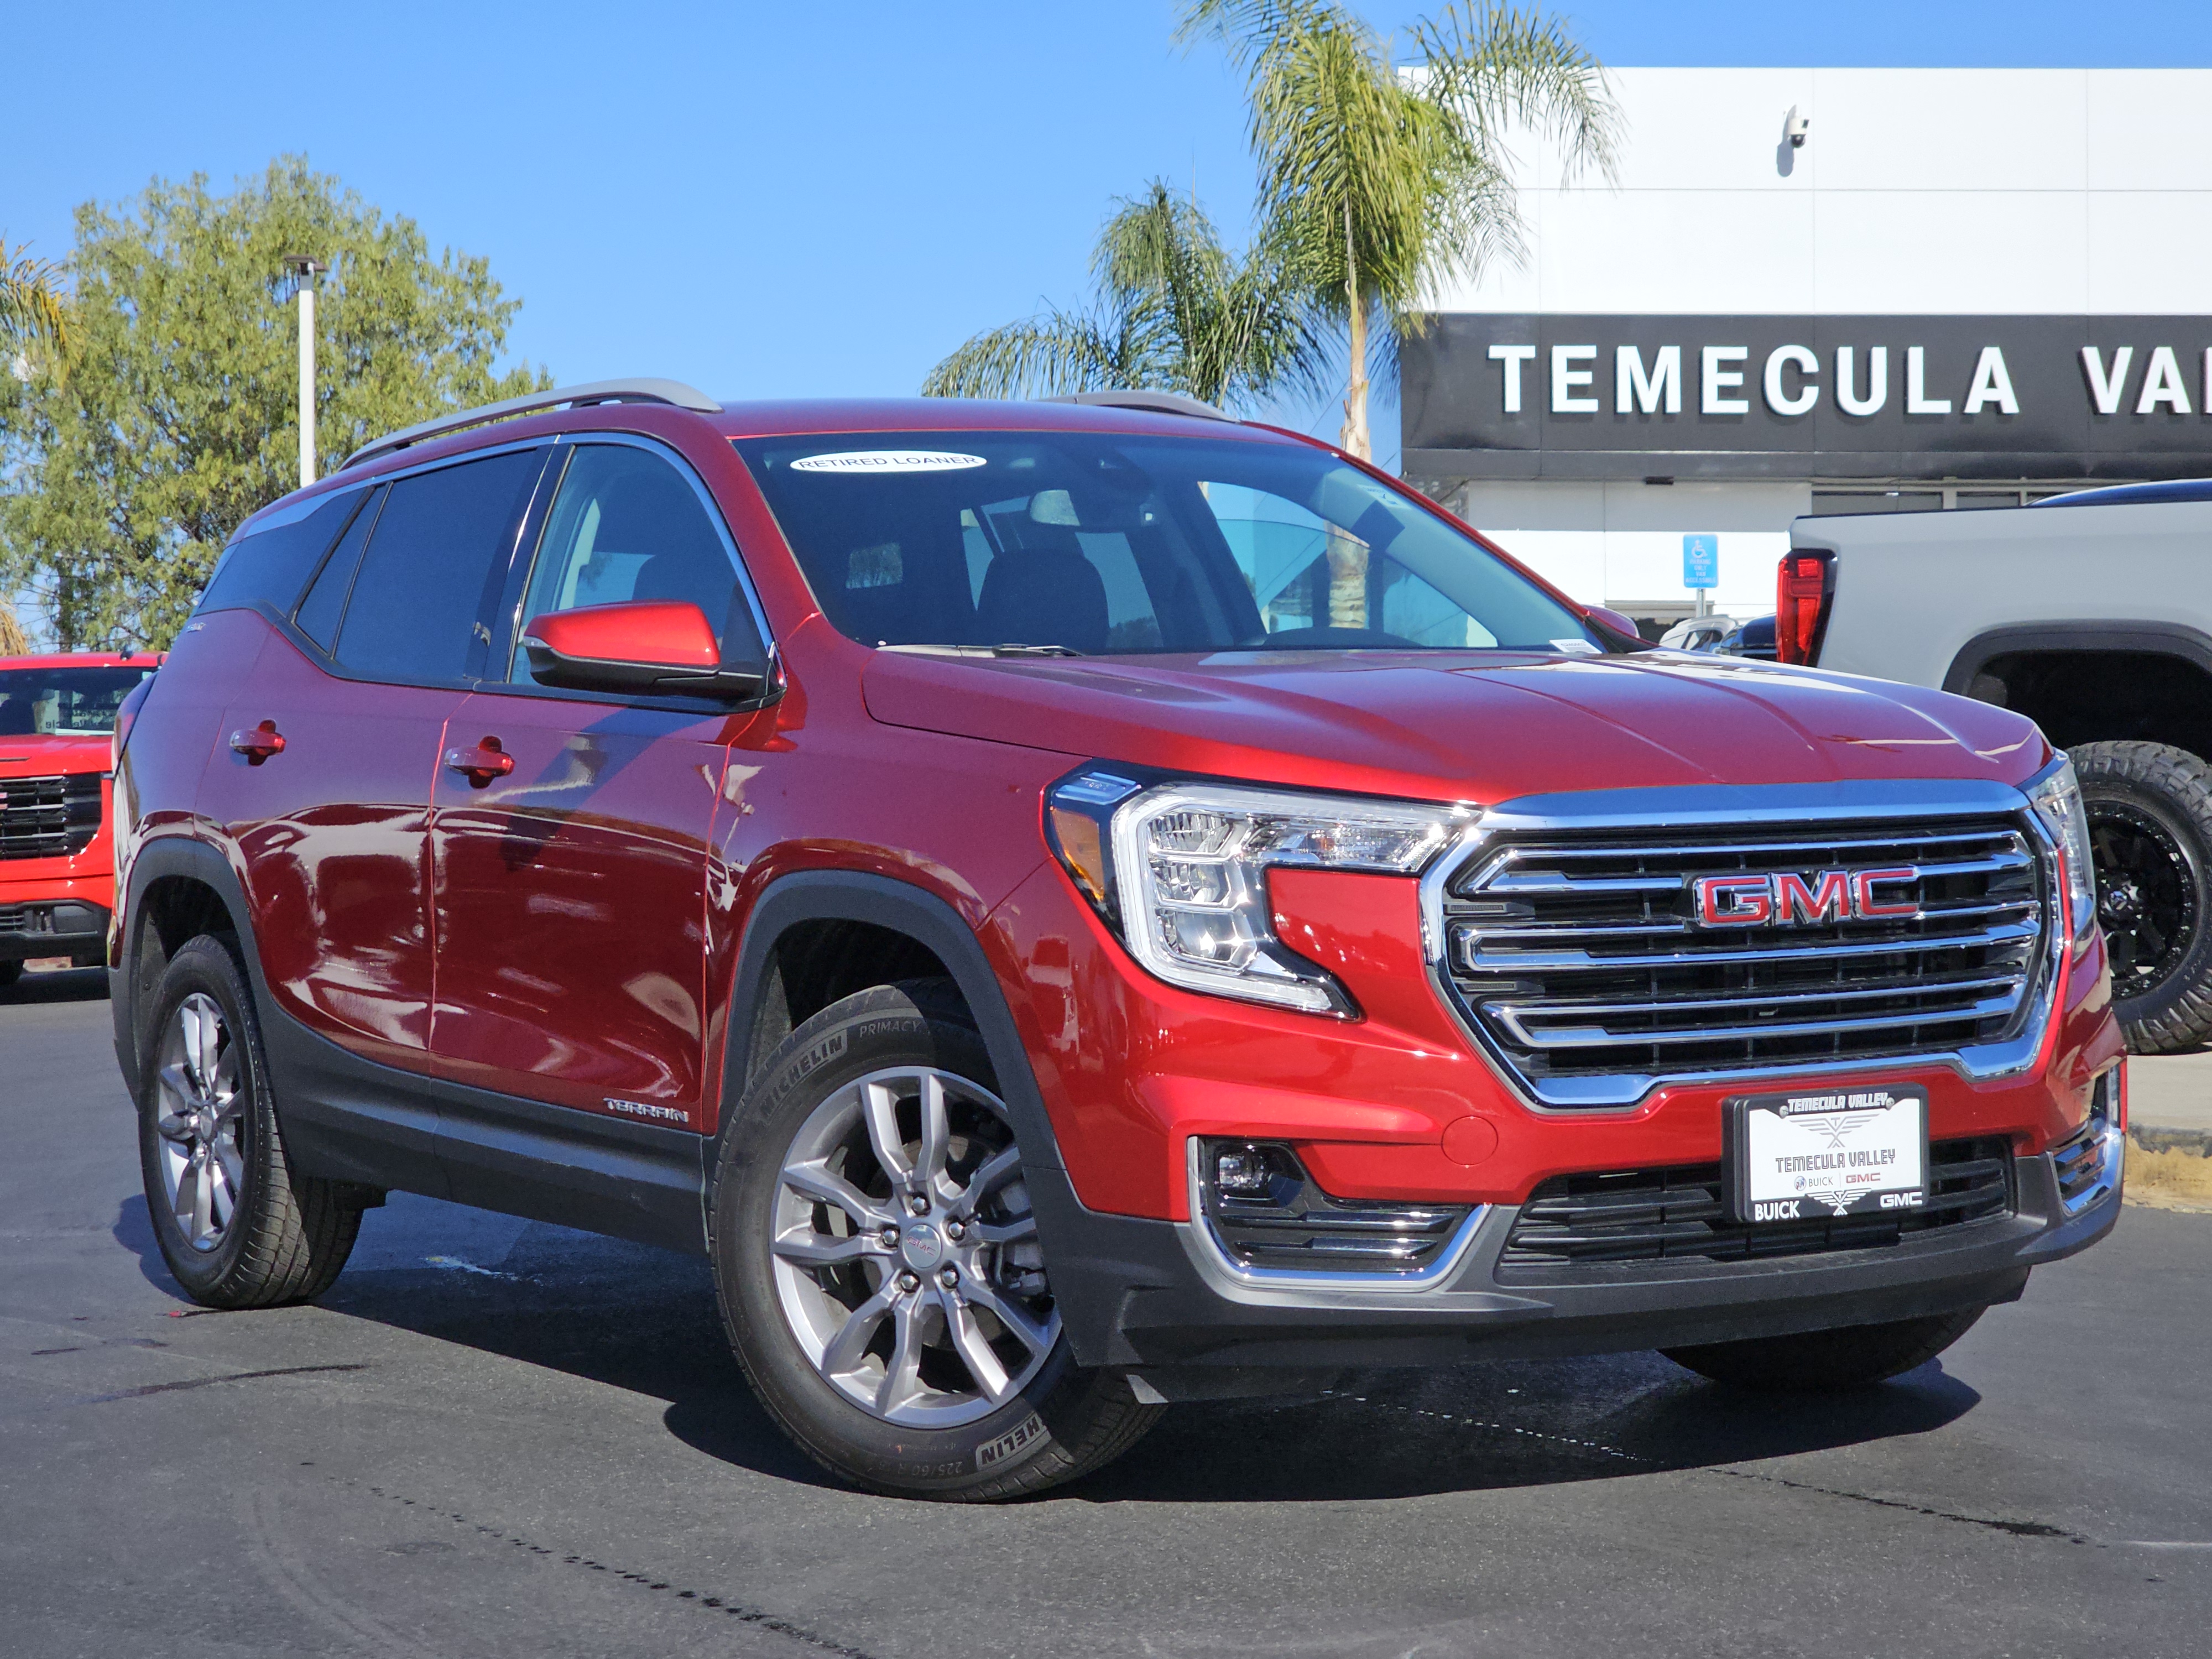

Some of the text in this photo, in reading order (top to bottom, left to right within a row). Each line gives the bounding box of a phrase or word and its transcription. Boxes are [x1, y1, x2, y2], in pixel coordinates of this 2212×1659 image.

[1488, 345, 2212, 415] TEMECULA VA
[798, 456, 980, 468] RETIRED LOANER
[1693, 867, 1920, 927] GMC
[760, 1020, 922, 1117] MICHELIN PRIMACY
[603, 1097, 688, 1123] TERRAIN
[1788, 1092, 1888, 1112] TEMECULA VALLEY
[1776, 1149, 1896, 1173] TEMECULA VALLEY
[1808, 1172, 1881, 1187] BUICK GMC
[1754, 1192, 1922, 1221] BUICK GMC
[907, 1236, 936, 1256] GMC
[981, 1416, 1040, 1465] HELIN
[911, 1461, 963, 1477] 225/60
